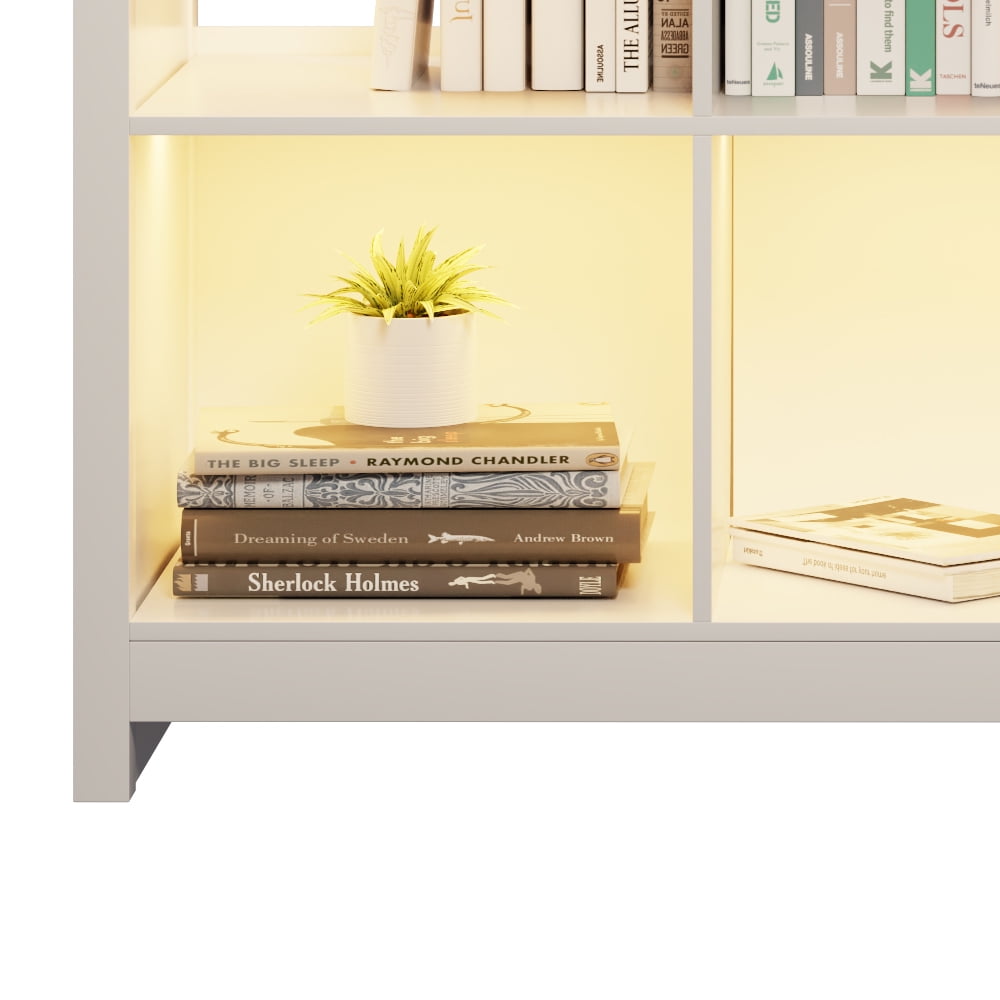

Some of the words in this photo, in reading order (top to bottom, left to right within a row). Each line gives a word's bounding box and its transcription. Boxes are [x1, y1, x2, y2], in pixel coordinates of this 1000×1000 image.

[884, 0, 893, 8] to
[884, 10, 894, 28] find
[884, 30, 894, 53] them
[624, 38, 639, 72] THE
[804, 33, 813, 81] ASSOULINE
[836, 32, 844, 79] ASSOULINE
[207, 459, 241, 469] THE
[248, 459, 281, 468] BIG
[289, 458, 340, 468] SLEEP
[367, 456, 463, 467] RAYMOND
[471, 455, 570, 466] CHANDLER
[234, 533, 318, 546] Dreaming
[321, 533, 339, 544] of
[343, 533, 409, 544] Sweden
[513, 533, 565, 543] Andrew
[571, 533, 614, 543] Brown
[248, 572, 337, 592] Sherlock
[345, 572, 419, 592] Holmes
